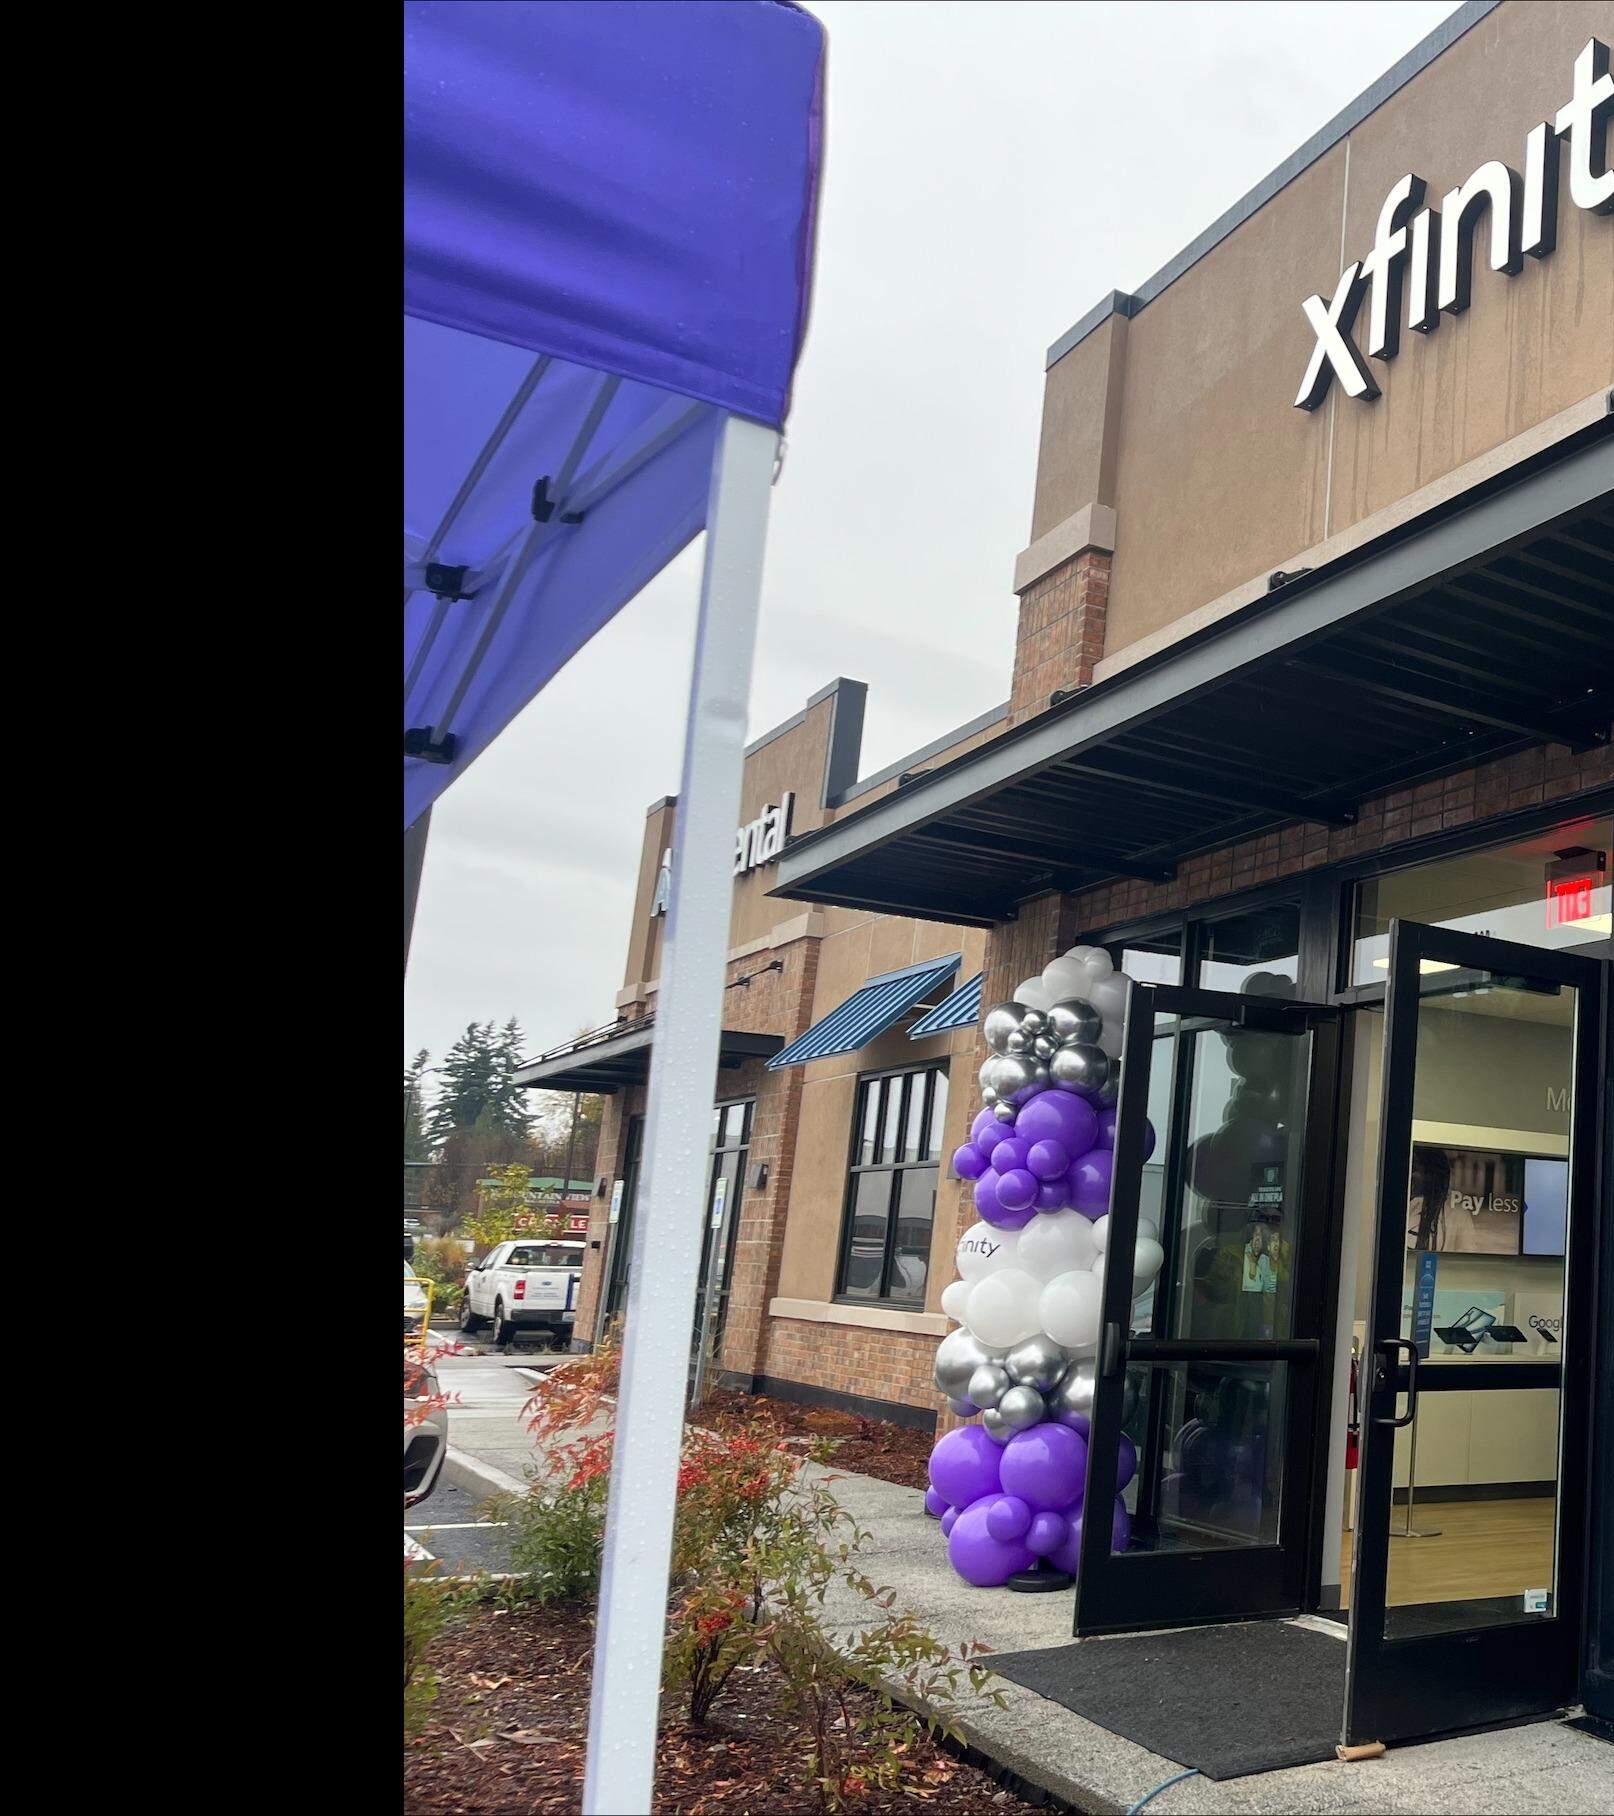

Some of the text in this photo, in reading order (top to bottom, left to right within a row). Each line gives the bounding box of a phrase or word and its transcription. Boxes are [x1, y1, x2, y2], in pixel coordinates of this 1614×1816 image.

[733, 788, 796, 876] ental
[1450, 1190, 1520, 1216] Pay less
